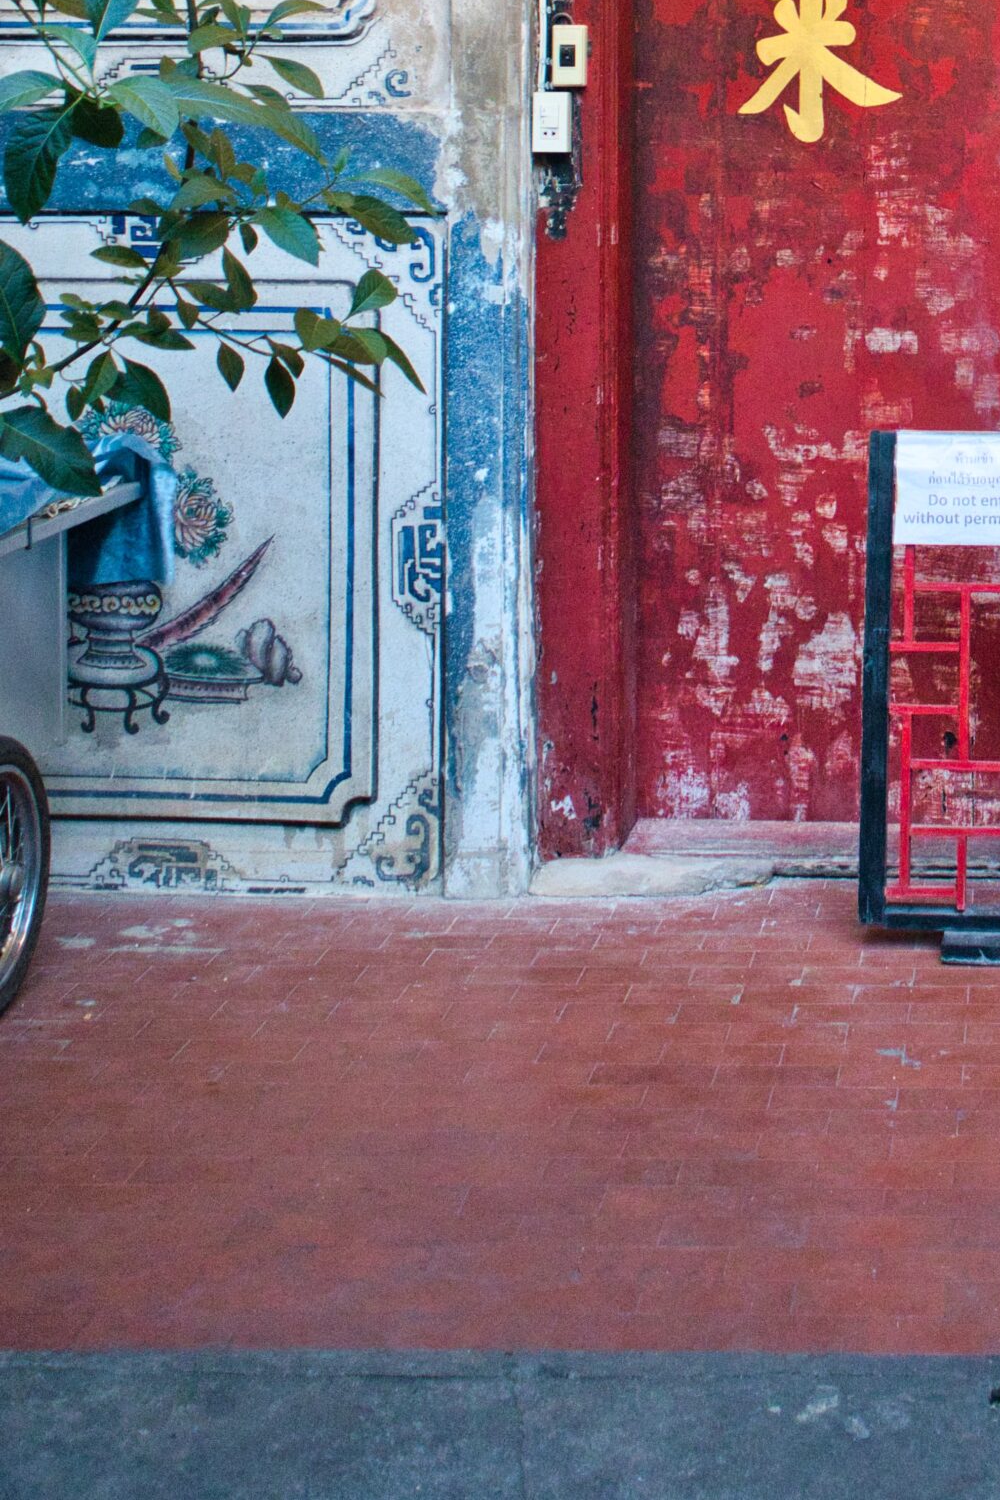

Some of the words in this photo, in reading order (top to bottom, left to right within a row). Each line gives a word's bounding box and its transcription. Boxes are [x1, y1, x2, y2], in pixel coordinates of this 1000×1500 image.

[928, 493, 948, 507] Do
[952, 494, 977, 507] not
[903, 511, 960, 525] without
